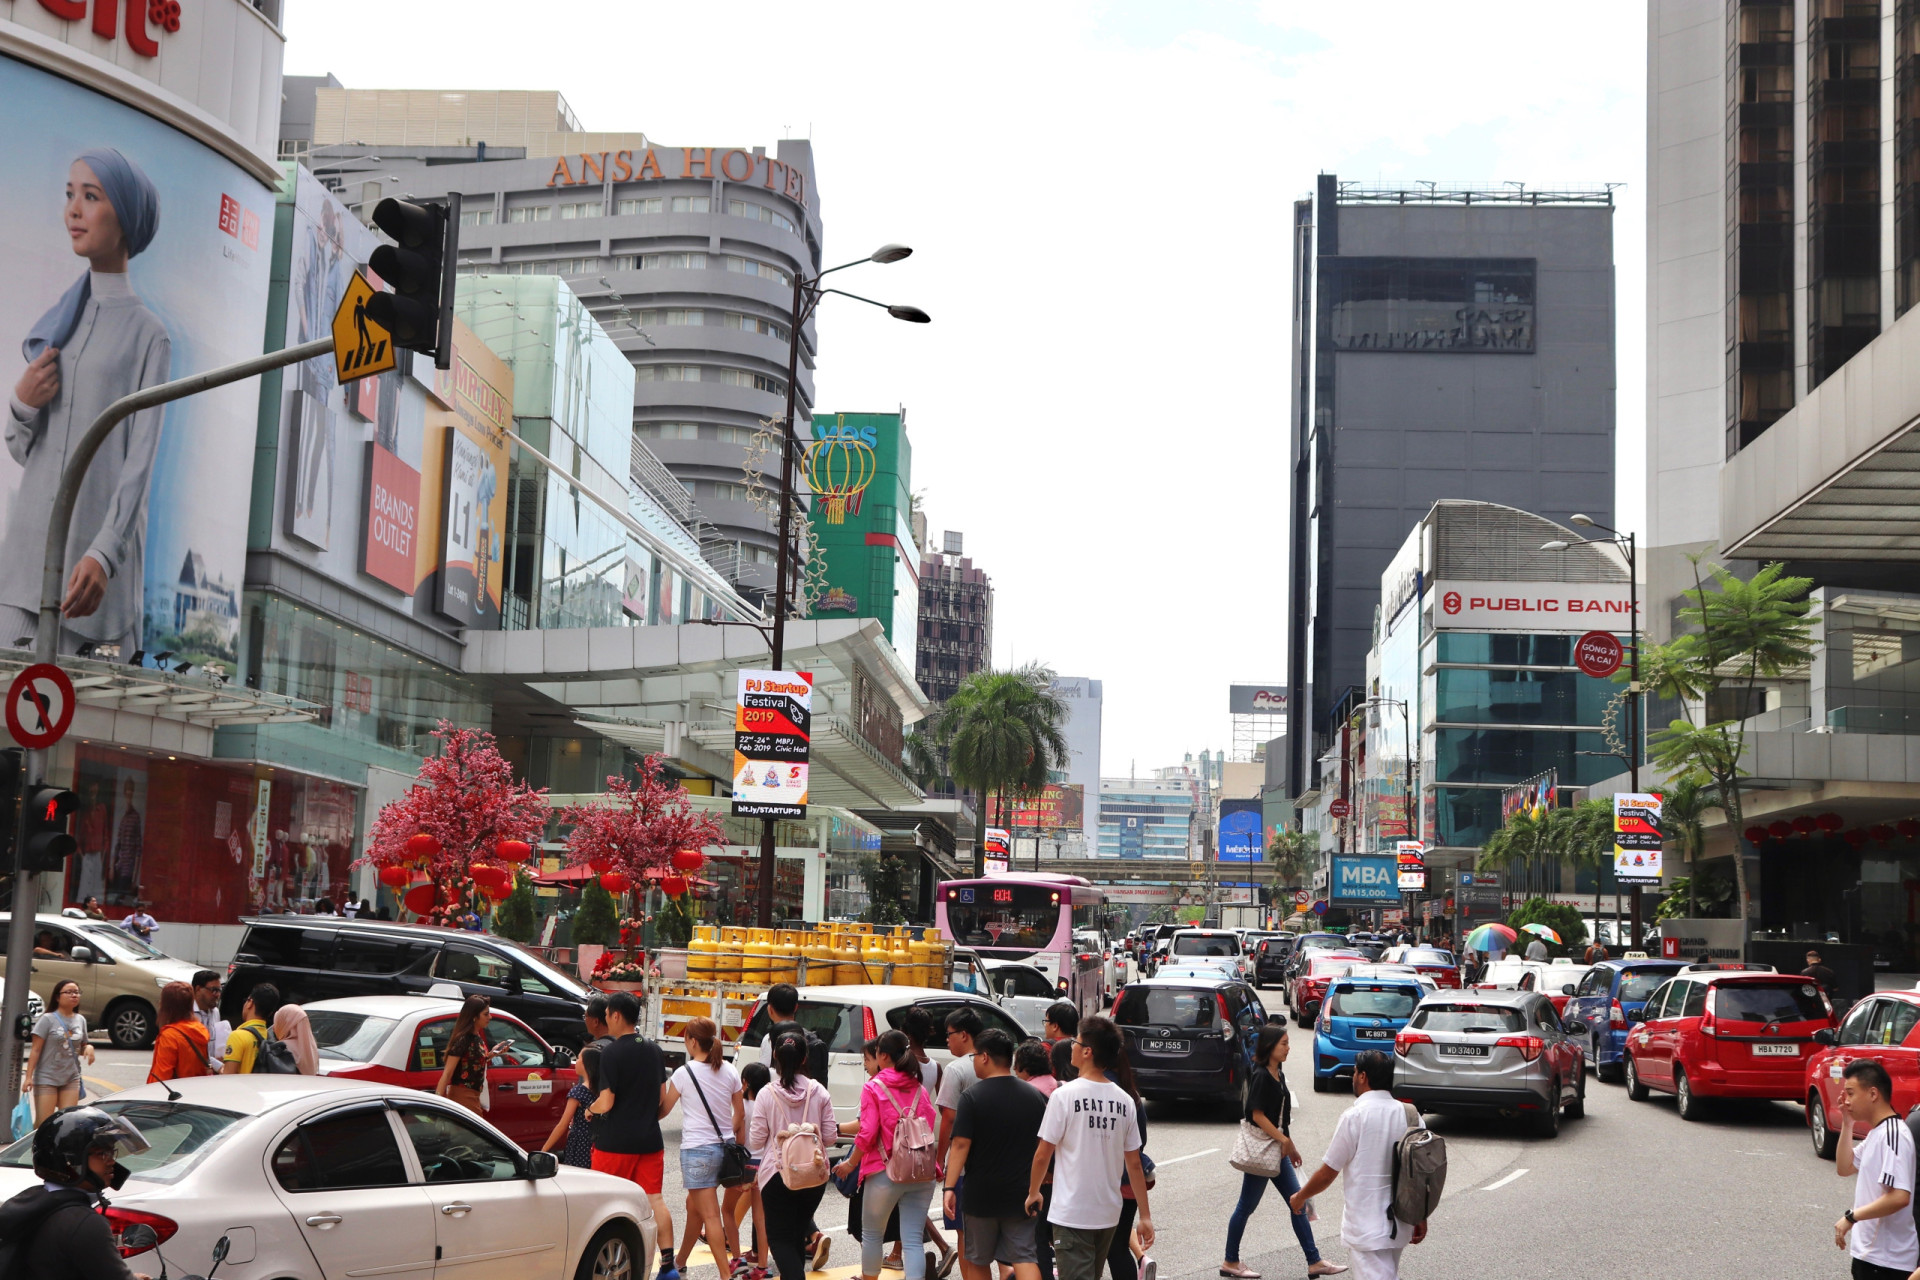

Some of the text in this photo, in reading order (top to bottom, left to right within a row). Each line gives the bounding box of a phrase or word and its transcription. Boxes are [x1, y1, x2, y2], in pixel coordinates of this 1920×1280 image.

[546, 147, 808, 210] ANSA HOTEL
[817, 425, 878, 458] yes
[374, 483, 414, 531] BRANDS
[817, 484, 865, 517] HM
[453, 492, 471, 550] L1
[373, 516, 412, 558] OUTLET
[1470, 597, 1642, 614] PUBLIC BANK
[1582, 642, 1618, 656] GONG XI
[1584, 653, 1612, 665] FA CAI
[746, 679, 808, 696] PJ Startup
[744, 695, 787, 708] Festival
[744, 710, 775, 723] 2019
[738, 743, 771, 752] Feb 2019
[775, 745, 792, 753] Civic
[1619, 799, 1659, 808] PJ Startup
[738, 805, 802, 816] bit.ly/STARTUP19
[1619, 809, 1647, 817] Festival
[1341, 866, 1392, 885] MBA
[1341, 888, 1387, 898] RM15,000
[1551, 899, 1581, 907] BANK
[1365, 1030, 1373, 1038] VC
[1165, 1041, 1182, 1049] 1555
[1446, 1046, 1481, 1056] WD 3740 D
[1758, 1044, 1793, 1053] HBA 7720
[1074, 1098, 1127, 1117] BEAT THE
[1089, 1115, 1117, 1130] BEST
